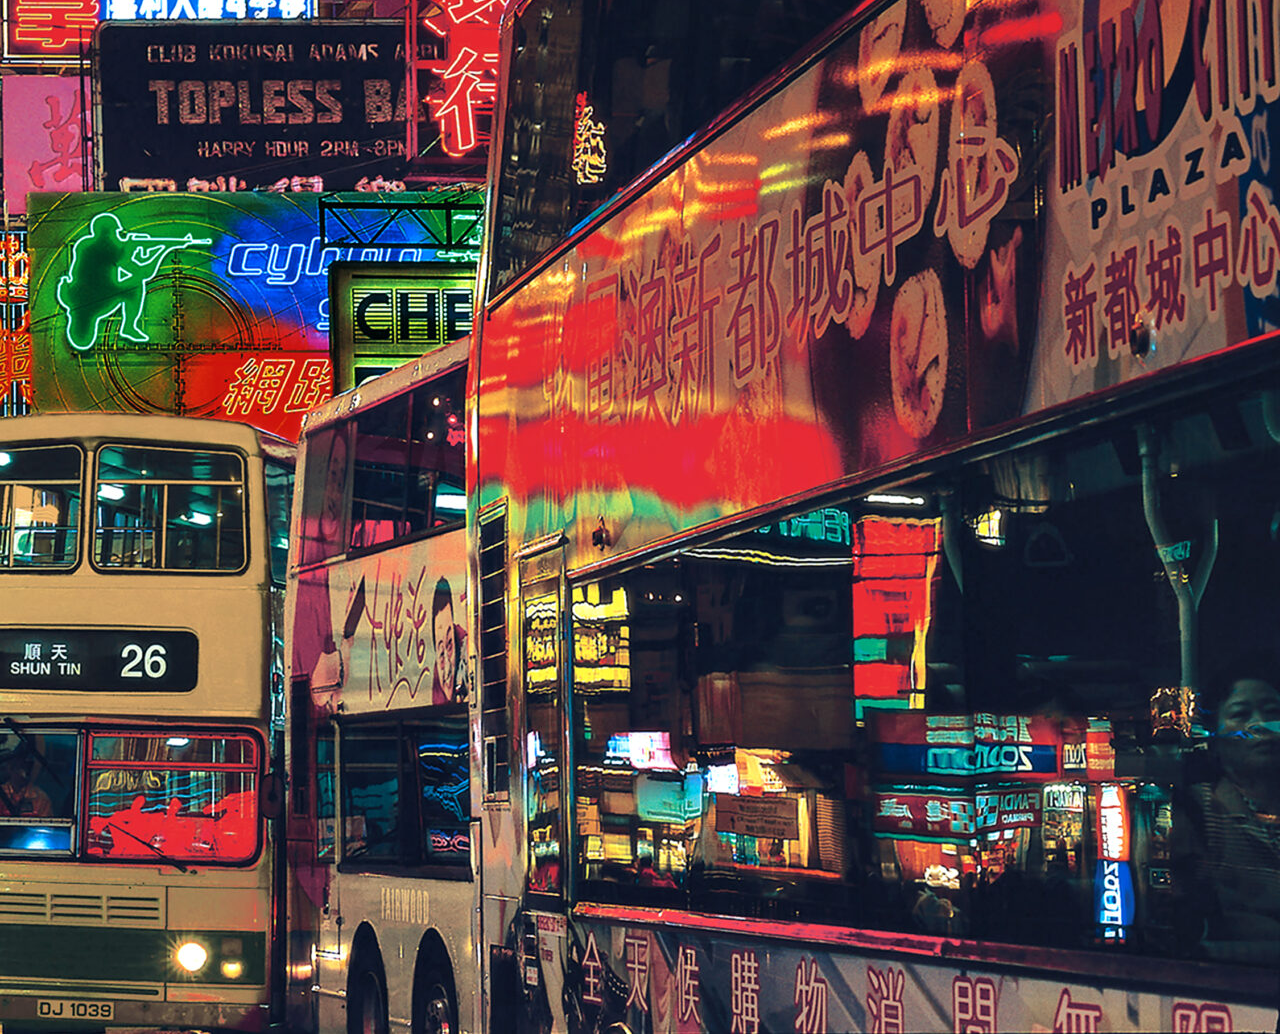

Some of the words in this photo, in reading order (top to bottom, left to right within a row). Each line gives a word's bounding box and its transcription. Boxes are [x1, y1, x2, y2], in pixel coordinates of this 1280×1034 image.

[147, 44, 196, 63] CLUB
[209, 44, 294, 63] KOKUSAI
[309, 43, 379, 62] ADAMS
[148, 79, 343, 124] TOPLESS
[364, 79, 432, 122] BA
[265, 141, 309, 157] HOUR
[1092, 132, 1246, 230] PLAZA
[545, 129, 1018, 428] 軍澳新都城中心
[1064, 192, 1280, 366] 新都城中心
[357, 293, 473, 340] CHE
[10, 662, 51, 675] SHUN
[58, 663, 81, 675] TIN
[24, 644, 67, 660] 順天
[120, 644, 167, 678] 26
[39, 1002, 63, 1016] DJ
[70, 1003, 112, 1017] 1039
